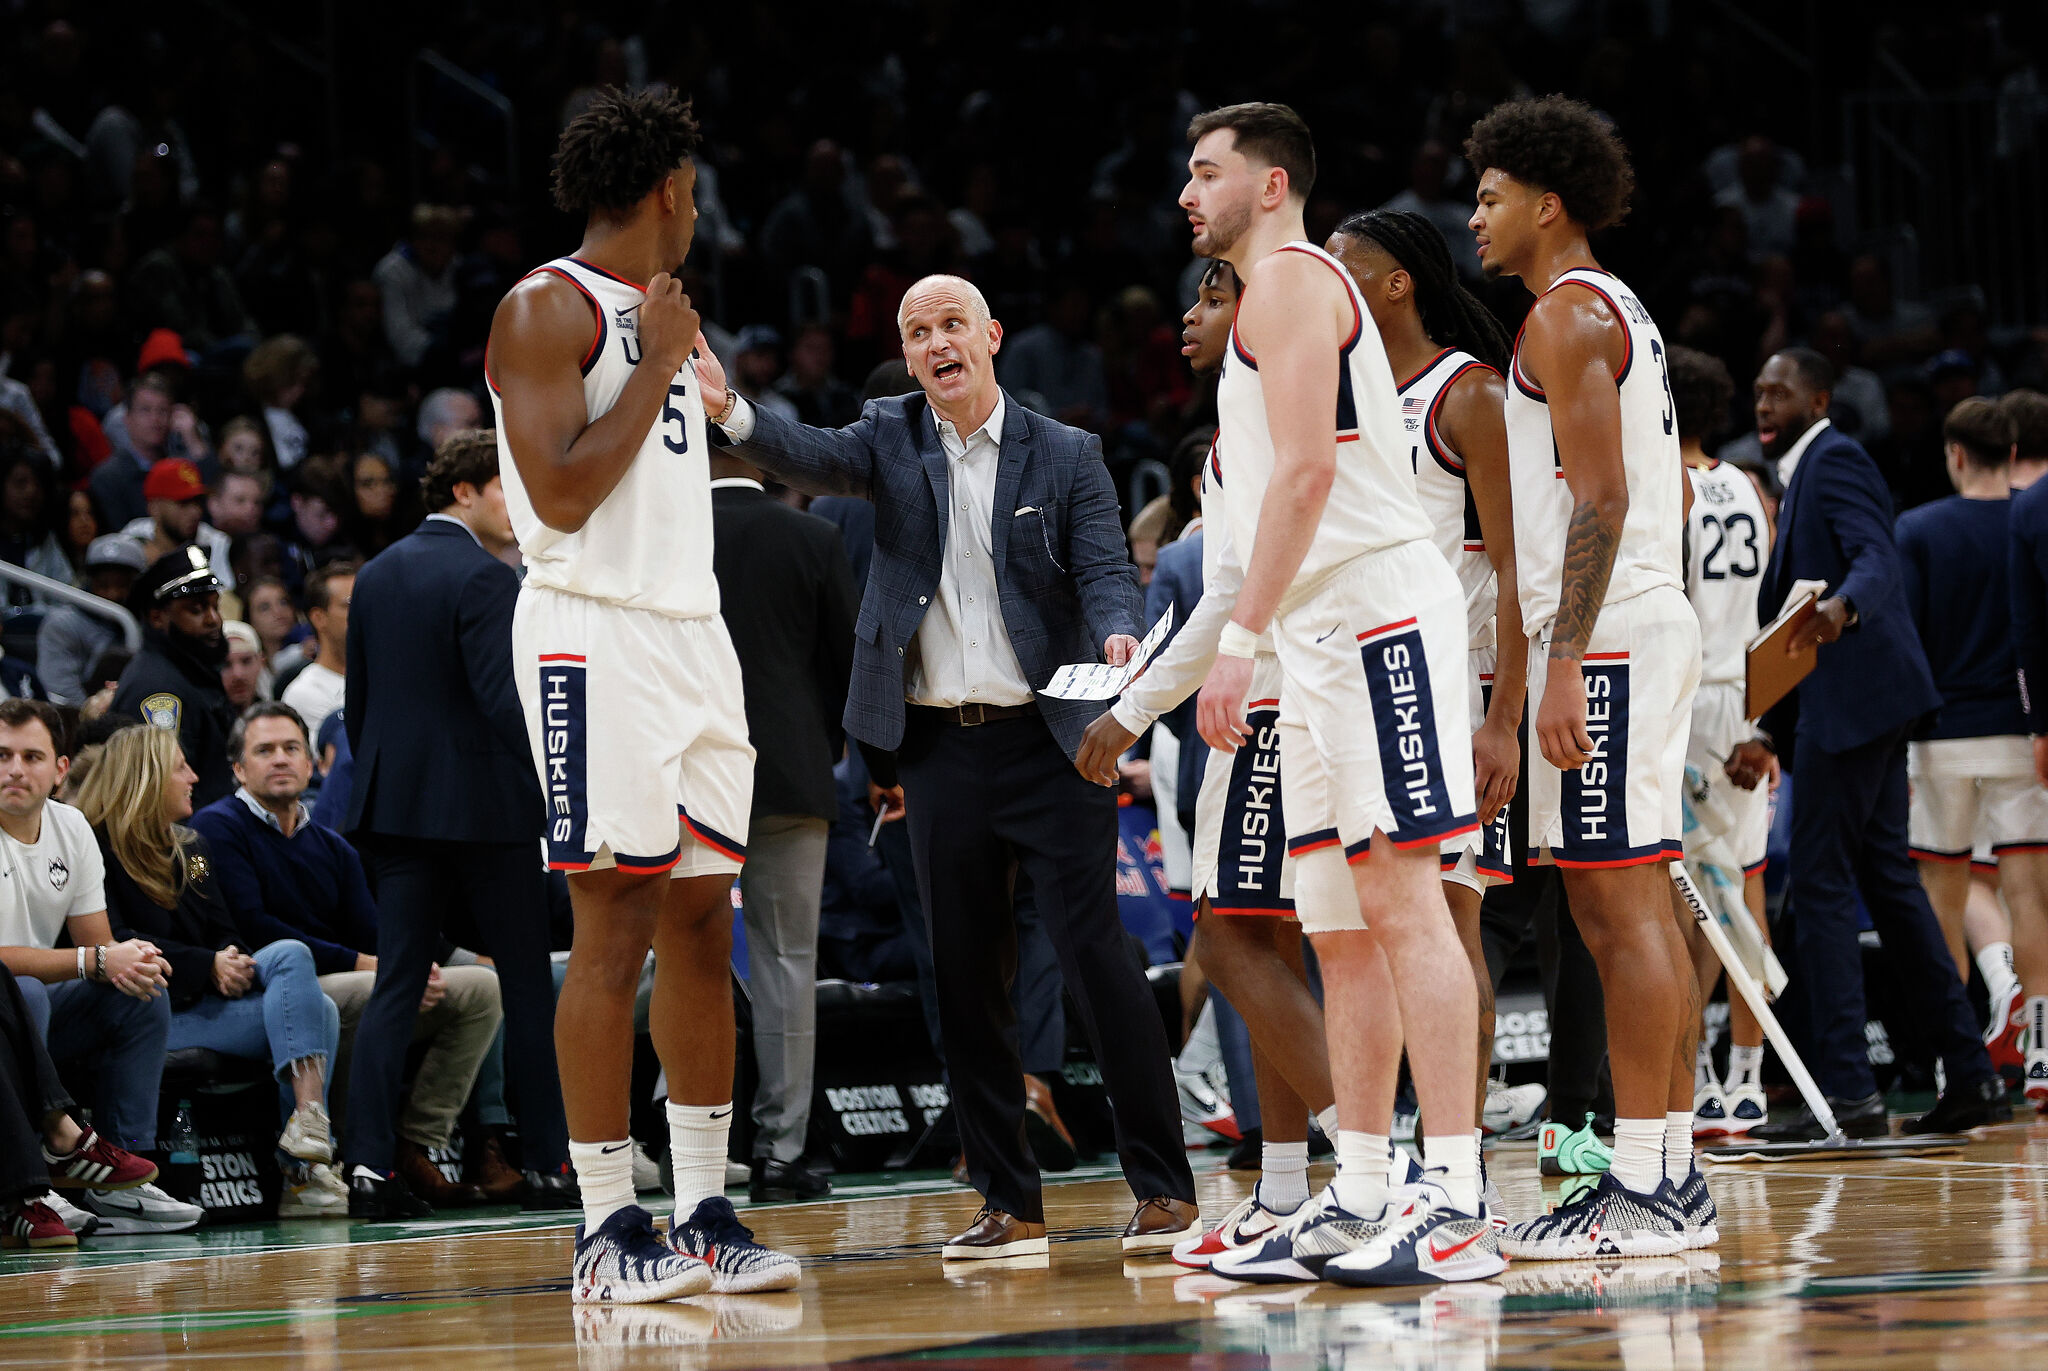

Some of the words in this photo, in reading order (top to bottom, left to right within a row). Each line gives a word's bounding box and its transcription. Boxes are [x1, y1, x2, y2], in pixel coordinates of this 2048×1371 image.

[663, 384, 688, 455] 5
[1702, 513, 1759, 579] 23
[546, 675, 572, 842] HUSKIES
[1383, 643, 1437, 817] HUSKIES
[1581, 674, 1611, 841] HUSKIES
[1237, 726, 1280, 890] HUSKIES
[825, 1084, 903, 1112] BOSTON
[841, 1109, 910, 1136] CELTICS
[188, 1180, 263, 1208] ELTICS
[200, 1152, 259, 1180] STON
